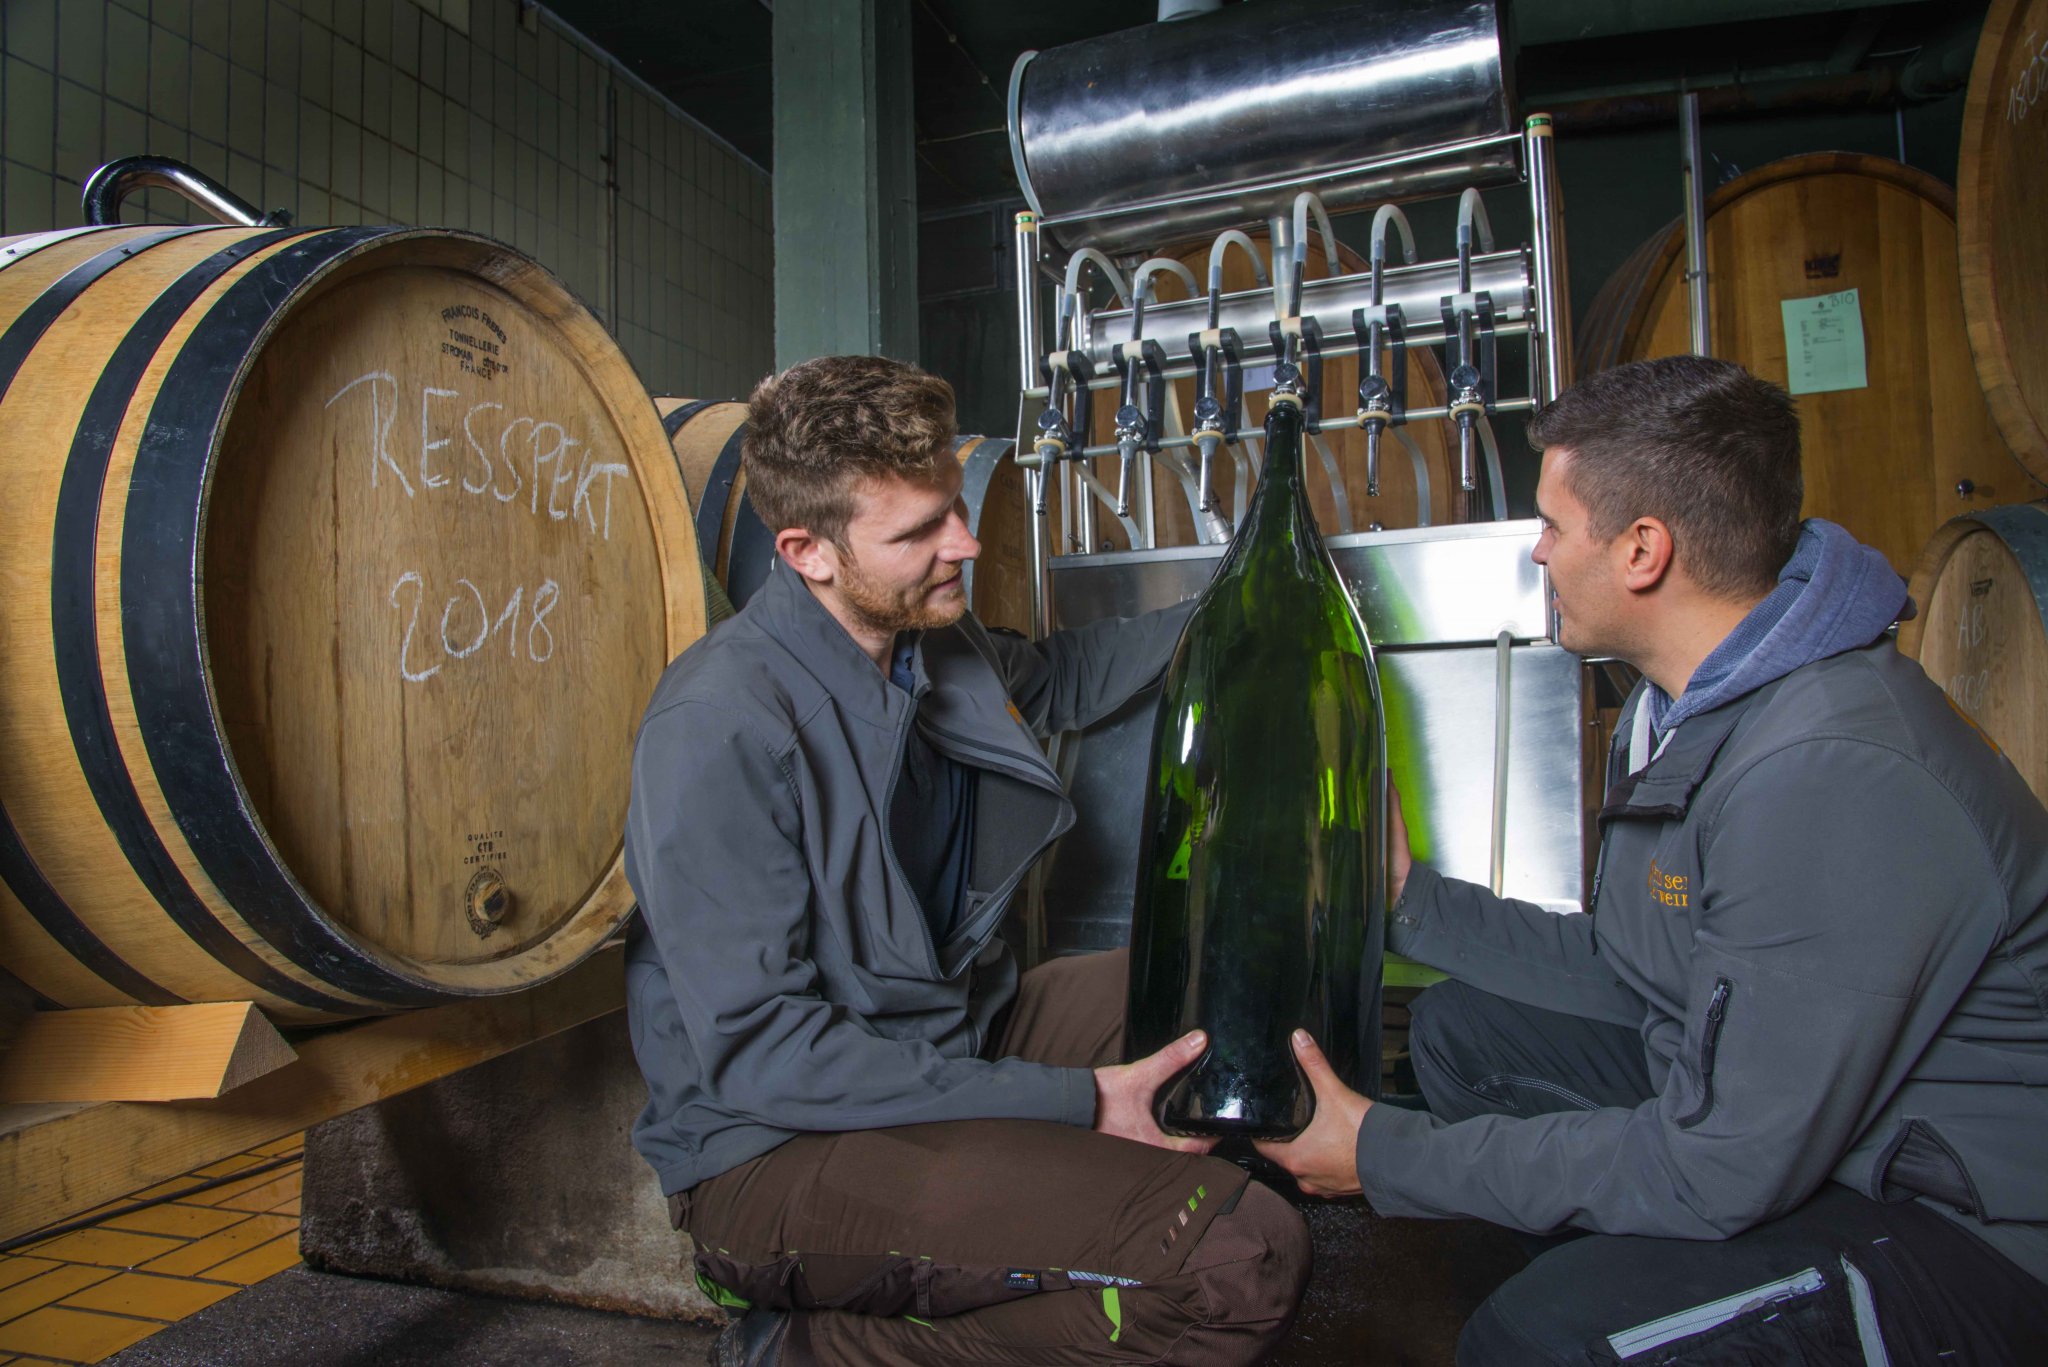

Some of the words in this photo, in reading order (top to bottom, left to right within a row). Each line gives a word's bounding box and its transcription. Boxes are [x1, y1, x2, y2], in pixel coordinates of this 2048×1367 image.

[1828, 292, 1855, 308] BIO
[449, 328, 499, 356] TONNELLERIE
[460, 360, 492, 380] FRANCE
[325, 369, 629, 540] RESSPEKT
[389, 571, 560, 682] 2018
[1957, 604, 1984, 650] AB
